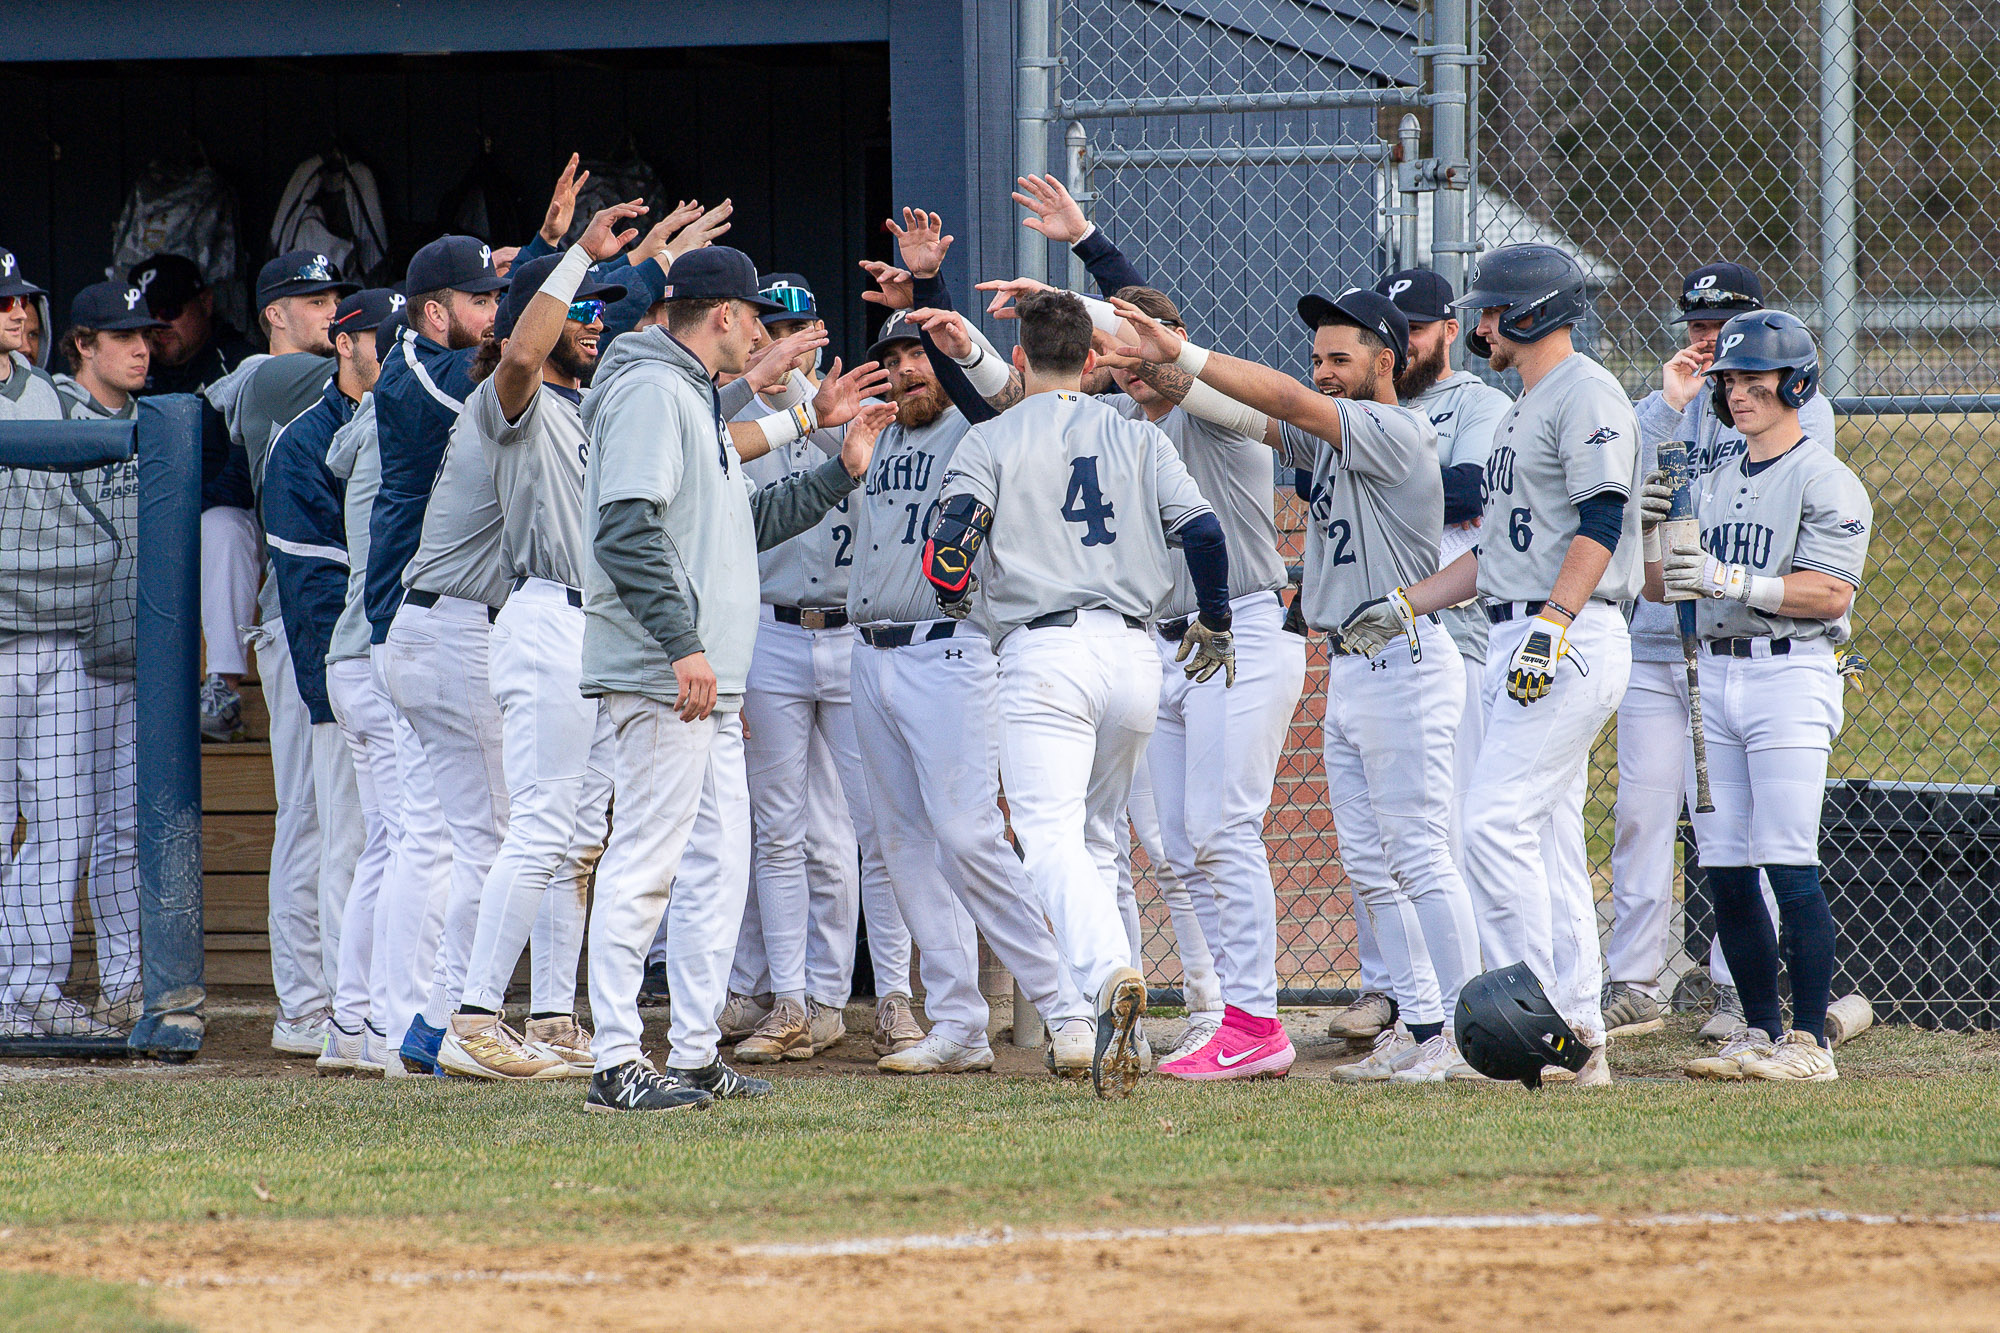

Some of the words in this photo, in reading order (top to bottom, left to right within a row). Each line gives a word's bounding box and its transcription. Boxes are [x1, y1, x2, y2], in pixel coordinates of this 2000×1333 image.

[1060, 456, 1117, 547] 4
[832, 524, 853, 568] 2
[1328, 519, 1357, 567] 2
[1509, 507, 1534, 552] 6
